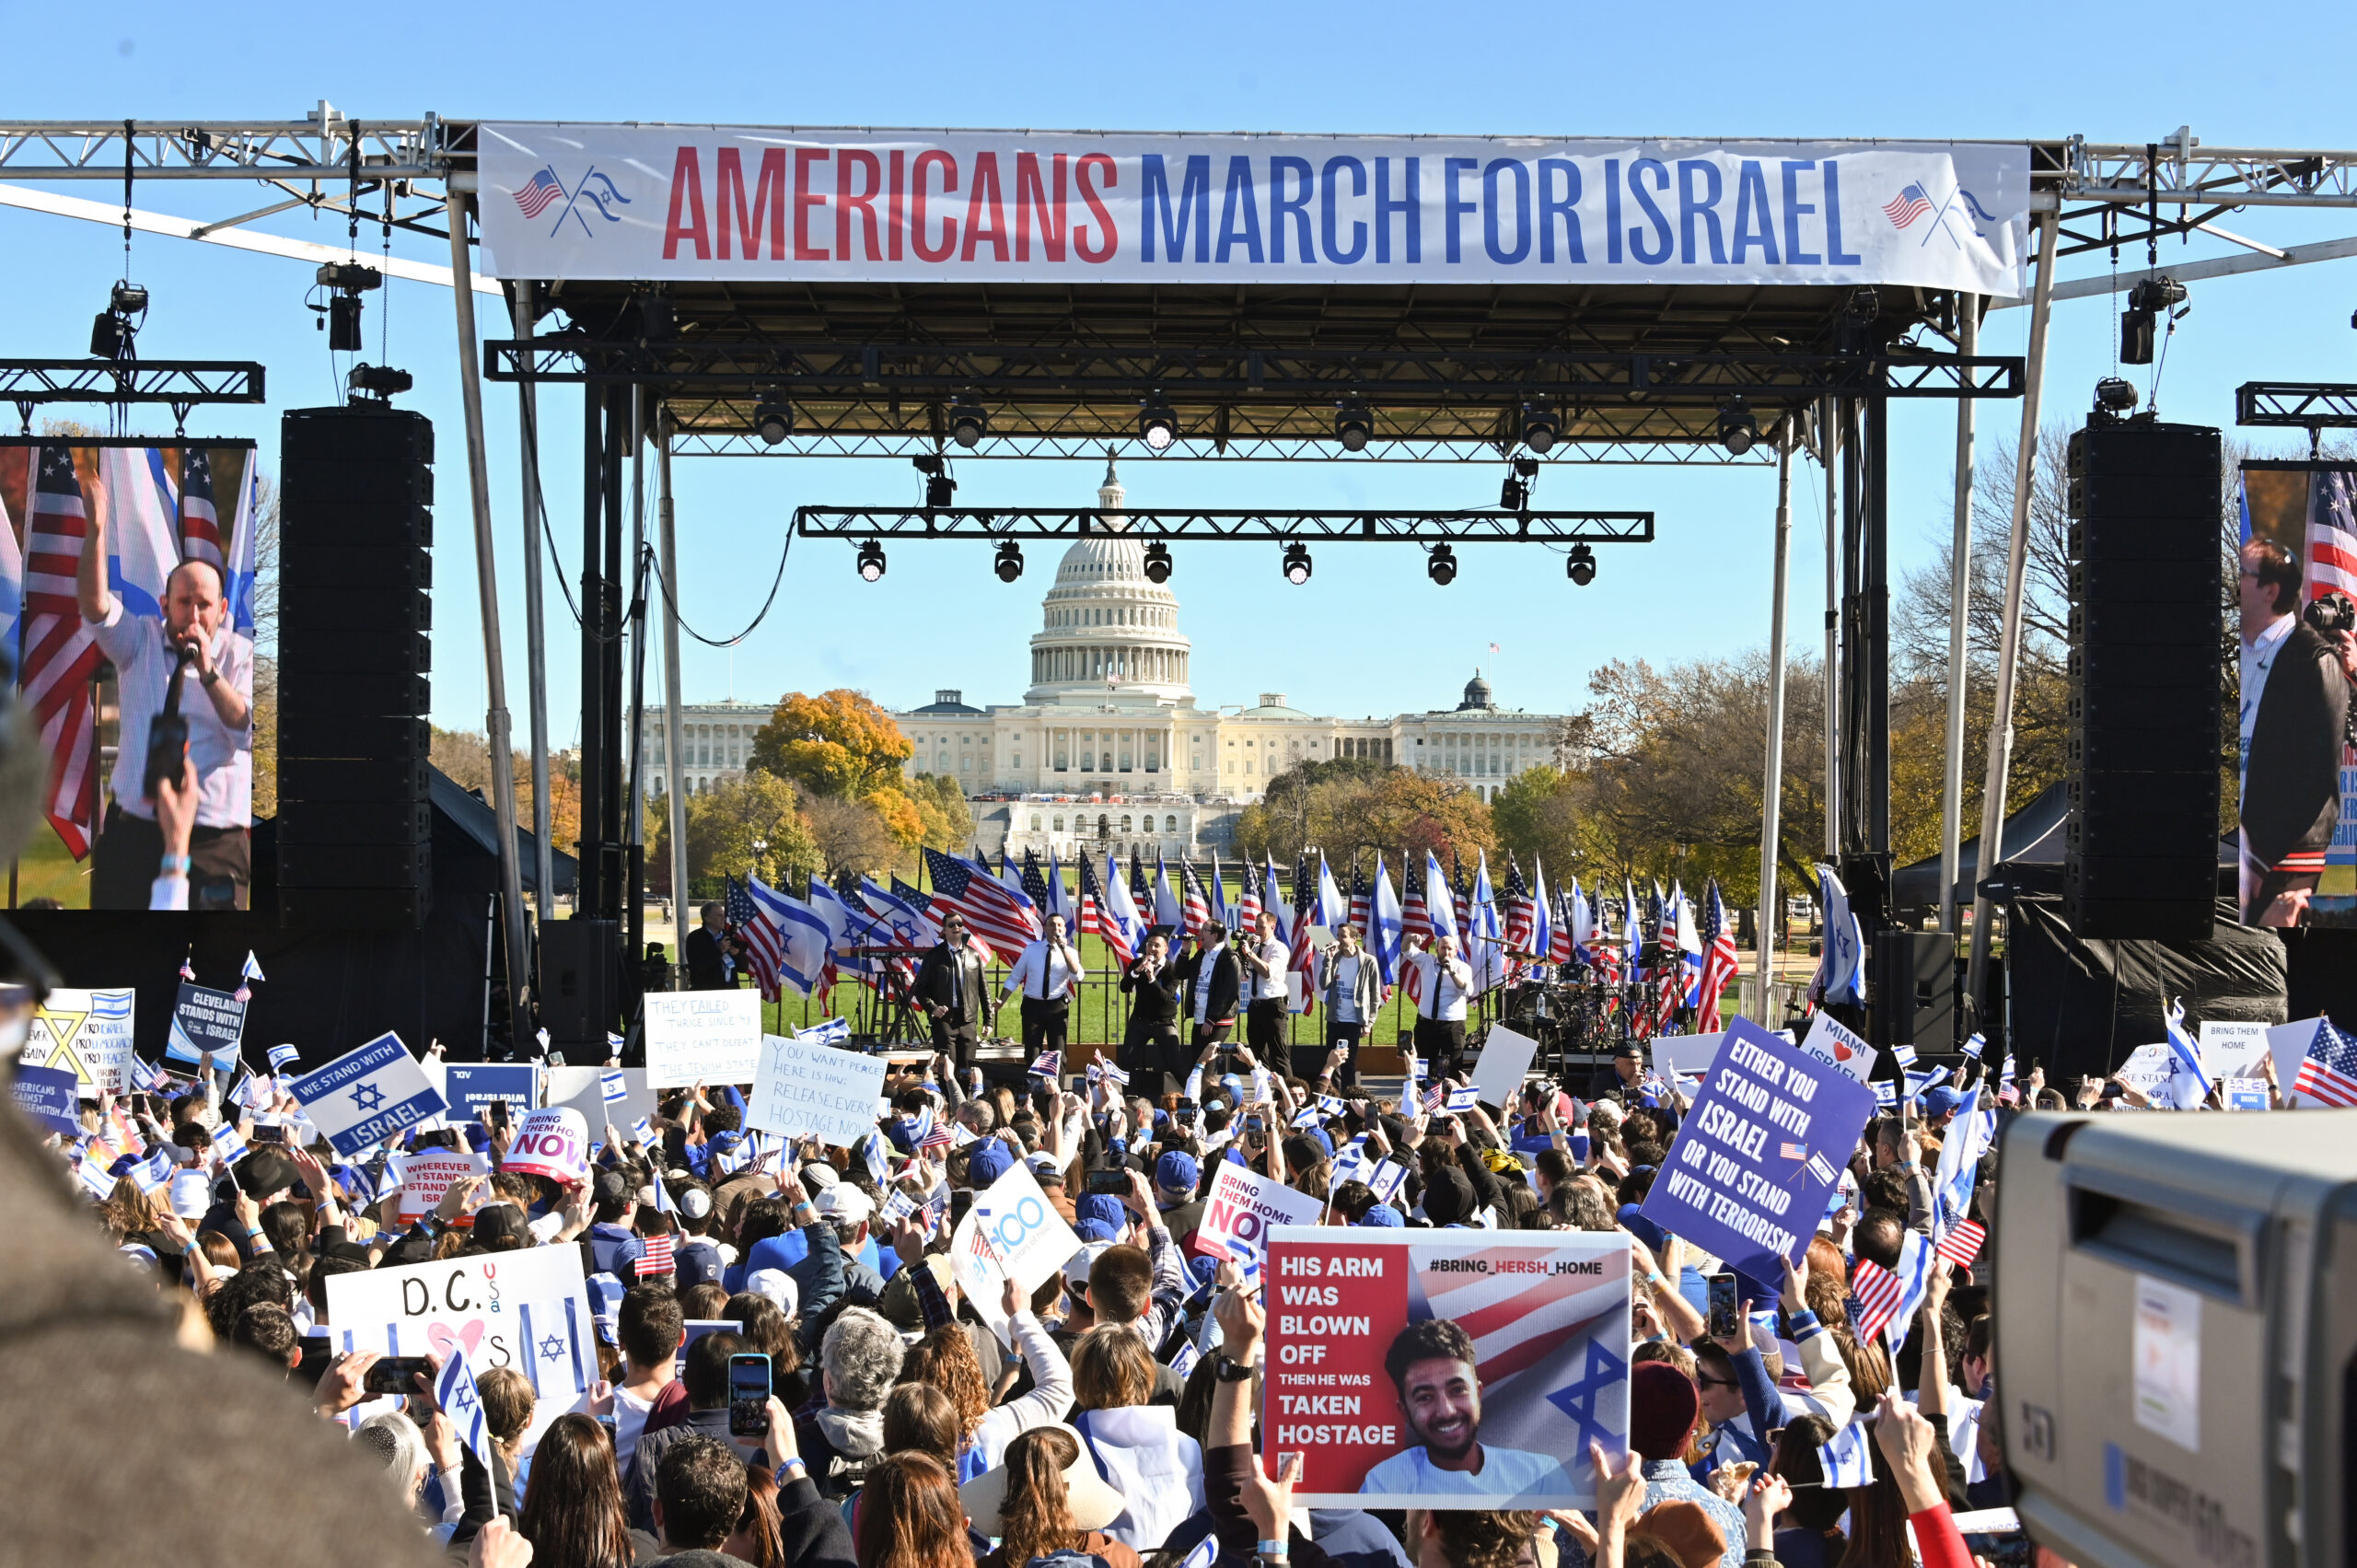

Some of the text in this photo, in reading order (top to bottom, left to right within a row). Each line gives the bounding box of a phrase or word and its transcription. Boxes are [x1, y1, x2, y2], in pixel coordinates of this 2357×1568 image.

[663, 145, 1861, 266] AMERICANS MARCH FOR ISRAEL
[192, 992, 243, 1014] CLEVELAND
[650, 1000, 729, 1014] THEY FAILED
[179, 1003, 215, 1022] STANDS
[215, 1011, 240, 1028] WITH
[29, 1030, 48, 1041] EVER
[84, 1024, 127, 1034] PRO ISRAEL
[205, 1023, 238, 1041] ISRAEL
[1825, 1020, 1866, 1058] MIAMI
[2211, 1027, 2258, 1036] BRING THEM
[76, 1038, 133, 1049] PRO DEMOCRACY
[655, 1040, 686, 1054] THEY
[2222, 1041, 2246, 1050] HOME
[85, 1052, 127, 1063] PRO PEACE
[772, 1041, 804, 1061] YOU
[812, 1052, 845, 1068] WANT
[97, 1068, 121, 1078] BRING
[299, 1043, 395, 1097] WE STAND WITH
[452, 1071, 471, 1079] ADL
[725, 1060, 756, 1070] STATE
[773, 1060, 806, 1078] HERE
[812, 1072, 821, 1081] IS
[1729, 1036, 1818, 1103] EITHER YOU
[99, 1077, 121, 1086] THEM
[1715, 1068, 1811, 1138] STAND WITH
[349, 1101, 426, 1147] ISRAEL
[525, 1123, 555, 1133] THEM
[528, 1115, 562, 1124] BRING
[770, 1104, 834, 1132] HOSTAGE
[1697, 1099, 1769, 1163] ISRAEL
[405, 1163, 471, 1174] WHEREVER
[1681, 1138, 1792, 1216] OR YOU STAND
[407, 1182, 447, 1191] STAND
[1222, 1174, 1260, 1197] BRING
[1219, 1186, 1294, 1225] THEM HOME
[1666, 1168, 1796, 1256] WITH TERRORISM
[1208, 1199, 1272, 1251] NO
[1281, 1257, 1383, 1277] HIS ARM
[1430, 1259, 1603, 1276] #BRING_HERSH_HOME
[402, 1270, 482, 1316] D.C.
[1281, 1286, 1339, 1306] WAS
[1280, 1316, 1370, 1336] BLOWN
[1280, 1345, 1326, 1365] OFF
[1279, 1374, 1371, 1386] THEN HE WAS
[1279, 1395, 1361, 1415] TAKEN
[1277, 1424, 1396, 1446] HOSTAGE
